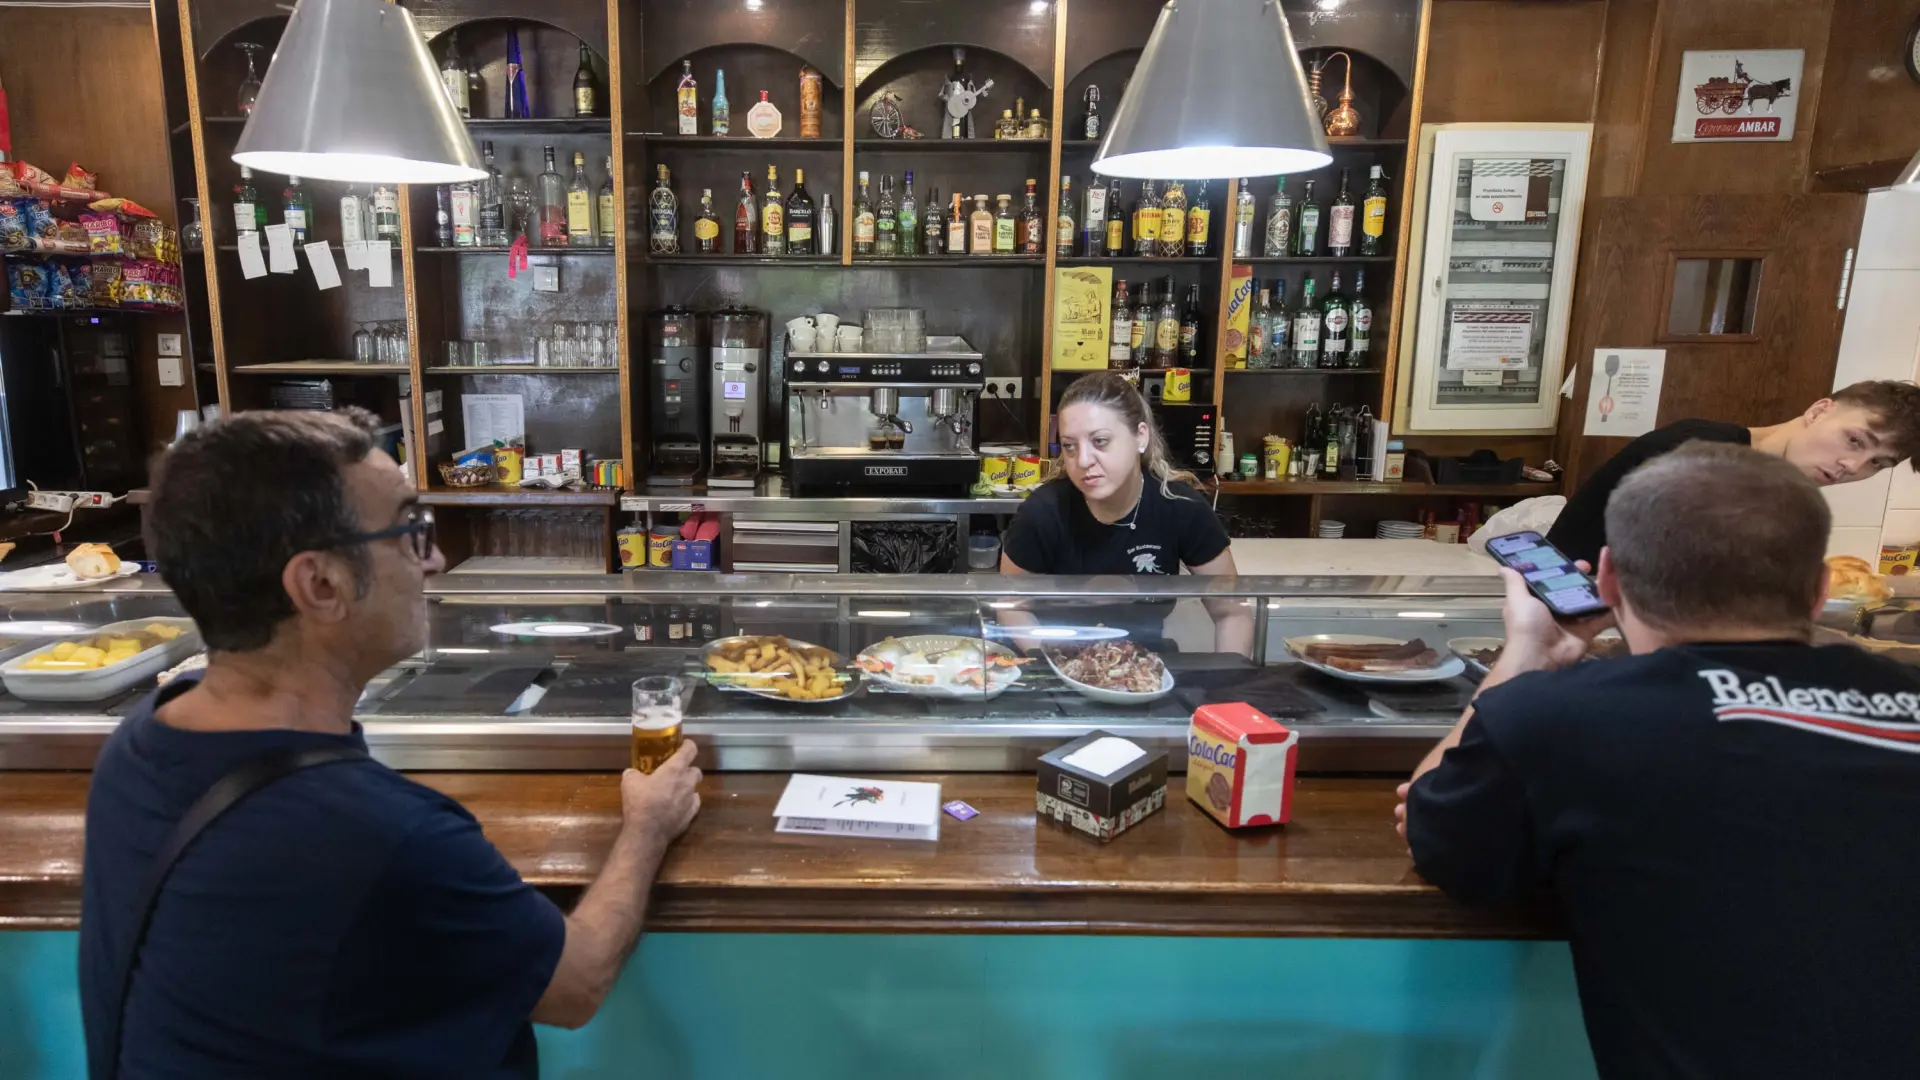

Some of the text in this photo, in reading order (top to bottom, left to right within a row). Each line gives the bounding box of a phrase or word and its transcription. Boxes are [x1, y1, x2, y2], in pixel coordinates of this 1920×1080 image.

[1737, 121, 1775, 133] AMBAR
[83, 219, 114, 230] HARIBO
[1226, 279, 1252, 320] laCao
[1697, 669, 1920, 721] Balenciag
